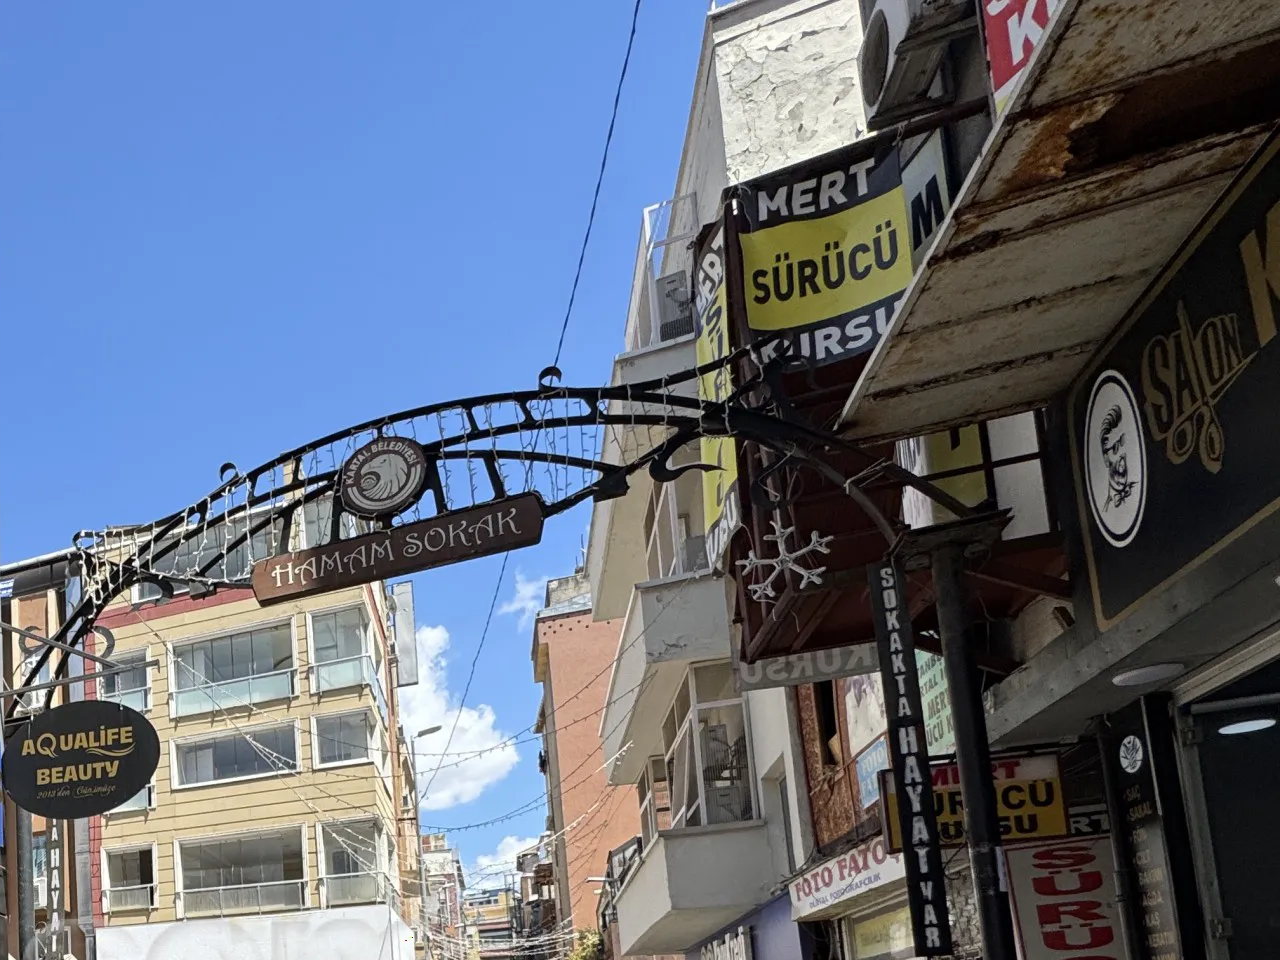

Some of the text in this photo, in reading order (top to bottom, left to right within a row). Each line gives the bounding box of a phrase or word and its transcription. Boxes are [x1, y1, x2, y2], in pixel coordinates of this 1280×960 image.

[758, 158, 875, 221] MERT
[752, 220, 898, 305] SÜRÜCÜ
[346, 450, 371, 485] KARTAL
[272, 508, 522, 588] HAMAM SOKAK
[36, 760, 120, 786] BEAUTY
[880, 567, 941, 948] SOKAKTA HAYAT VAR
[795, 866, 833, 902] FOTO
